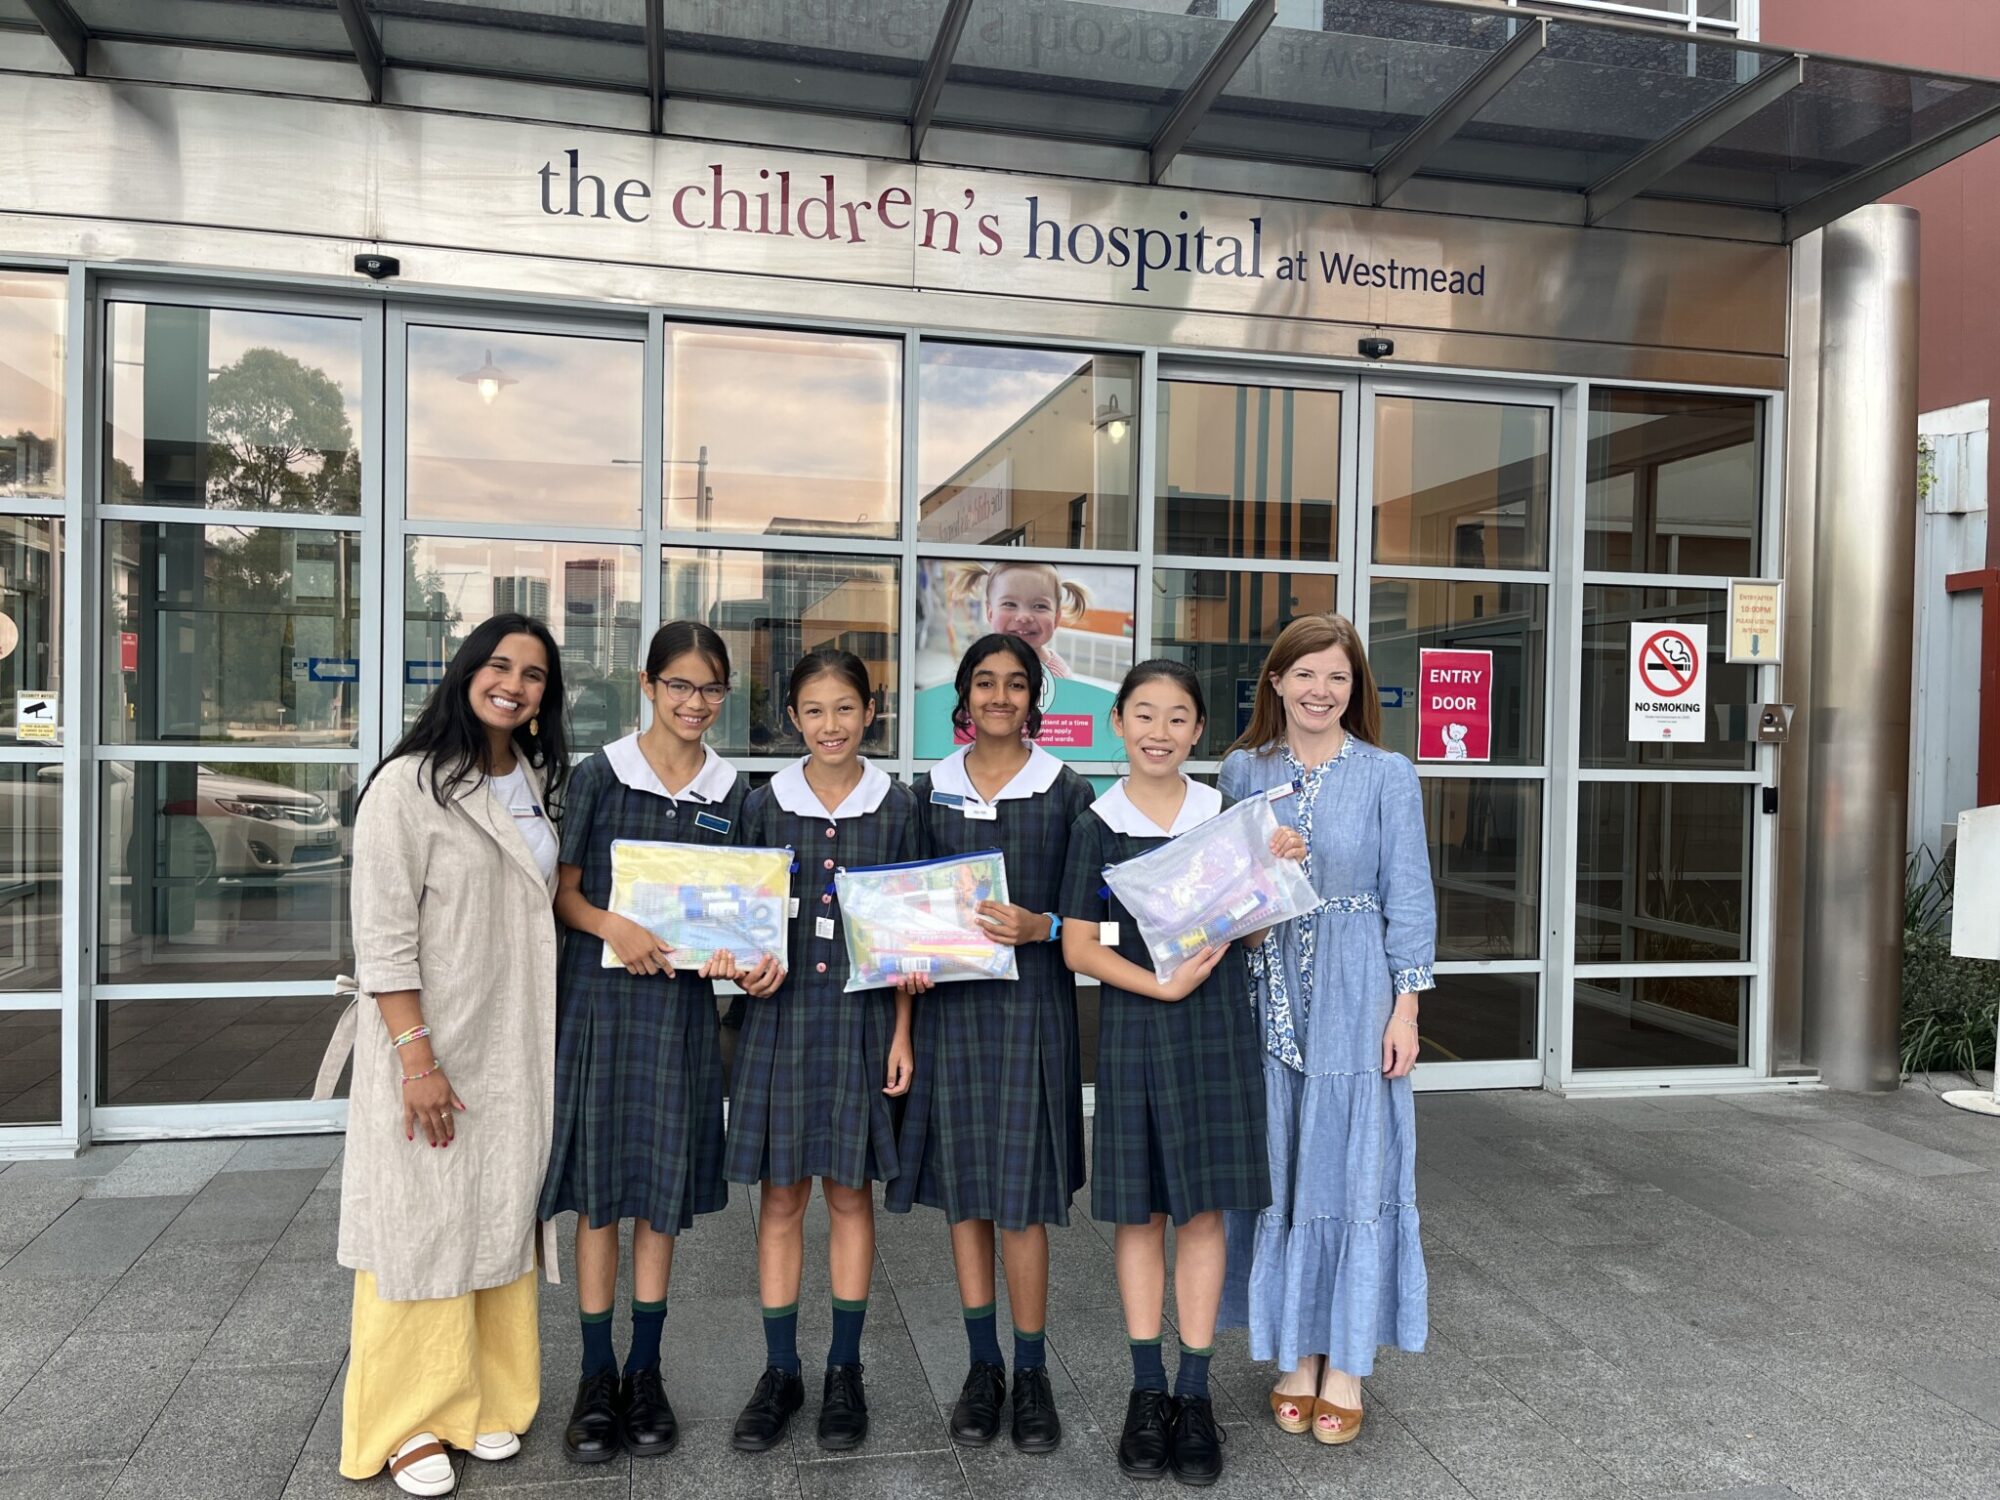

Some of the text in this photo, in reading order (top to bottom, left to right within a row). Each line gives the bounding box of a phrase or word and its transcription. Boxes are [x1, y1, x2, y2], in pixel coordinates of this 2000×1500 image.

[537, 148, 1486, 297] the children's hospital at Westmead
[1430, 669, 1483, 684] ENTRY
[1432, 696, 1477, 710] DOOR
[1634, 702, 1701, 713] NO SMOKING
